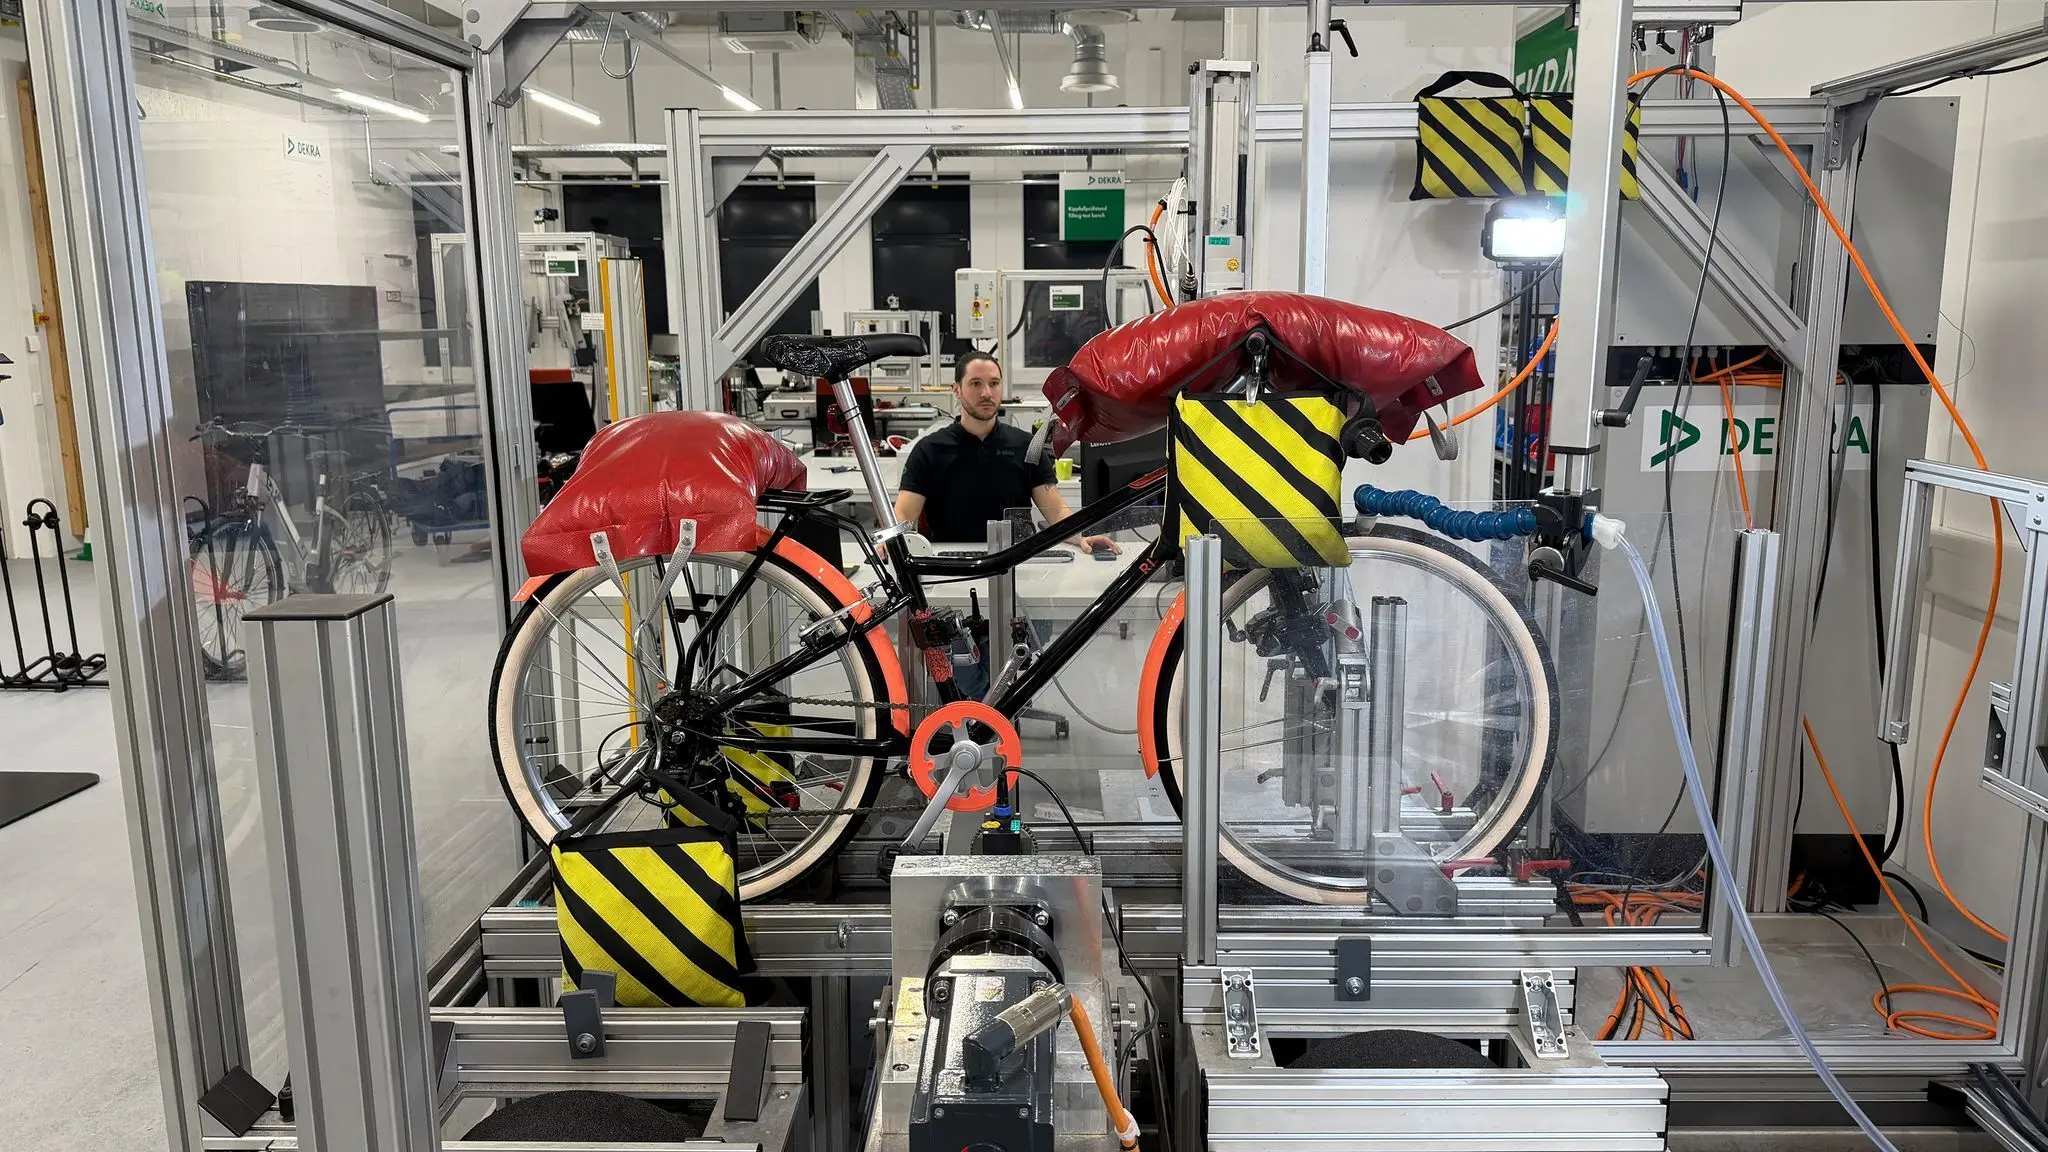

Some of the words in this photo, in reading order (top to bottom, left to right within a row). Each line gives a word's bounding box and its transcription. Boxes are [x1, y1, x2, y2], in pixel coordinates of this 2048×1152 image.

[297, 141, 321, 158] DEKRA
[1097, 176, 1122, 184] DEKRA
[1719, 415, 1871, 456] DEA
